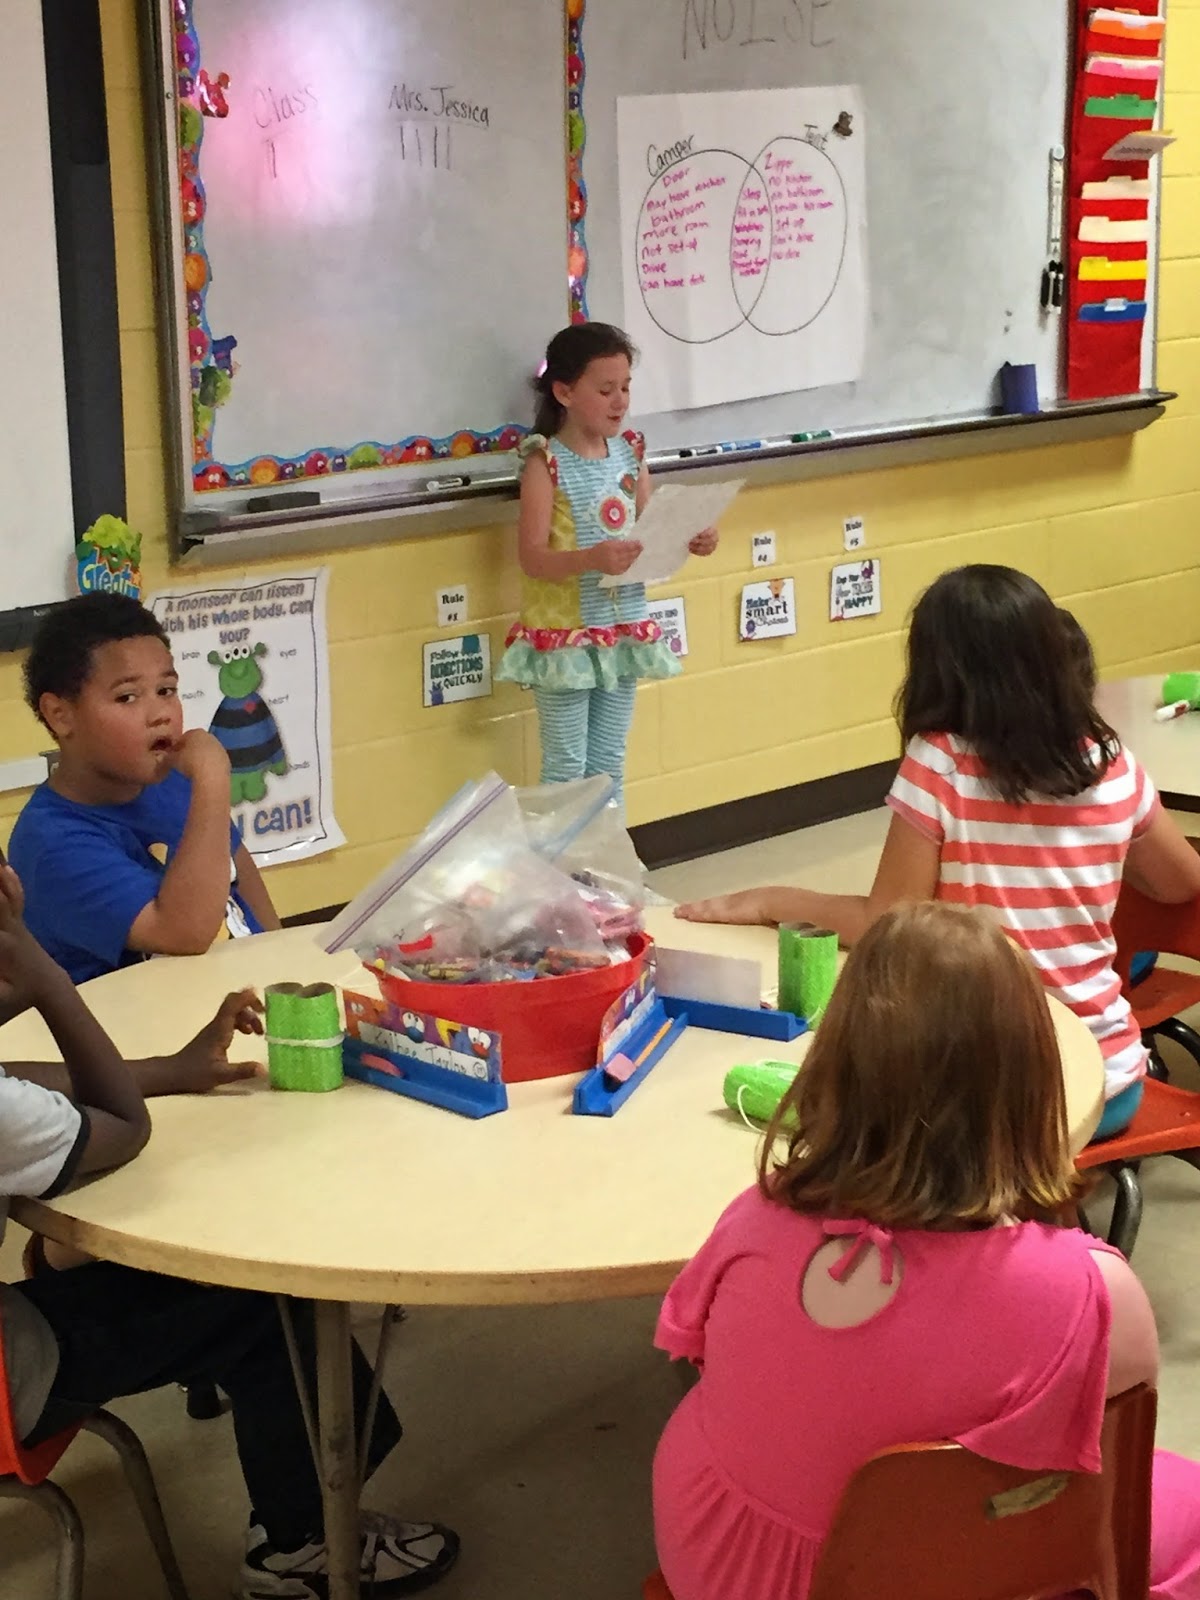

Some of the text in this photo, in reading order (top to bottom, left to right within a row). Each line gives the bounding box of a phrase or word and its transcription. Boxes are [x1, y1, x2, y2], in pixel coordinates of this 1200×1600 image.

[254, 84, 317, 128] Class
[389, 84, 489, 126] Mrs. Jessica
[647, 134, 694, 177] Camper
[651, 200, 706, 227] bathroom
[642, 226, 679, 240] more
[753, 536, 772, 546] Rule
[165, 582, 306, 612] A monster can listen
[441, 594, 465, 605] Rule
[844, 595, 873, 609] HAPPY
[162, 615, 185, 633] ith
[188, 611, 208, 630] his
[212, 608, 250, 625] whole
[253, 603, 287, 620] body.
[745, 600, 788, 618] smart
[219, 627, 251, 645] you?
[280, 648, 298, 660] eyes
[430, 649, 460, 663] Follow
[430, 656, 484, 679] DIRECTIONS
[443, 672, 483, 689] QUICKLY
[254, 798, 312, 835] can!
